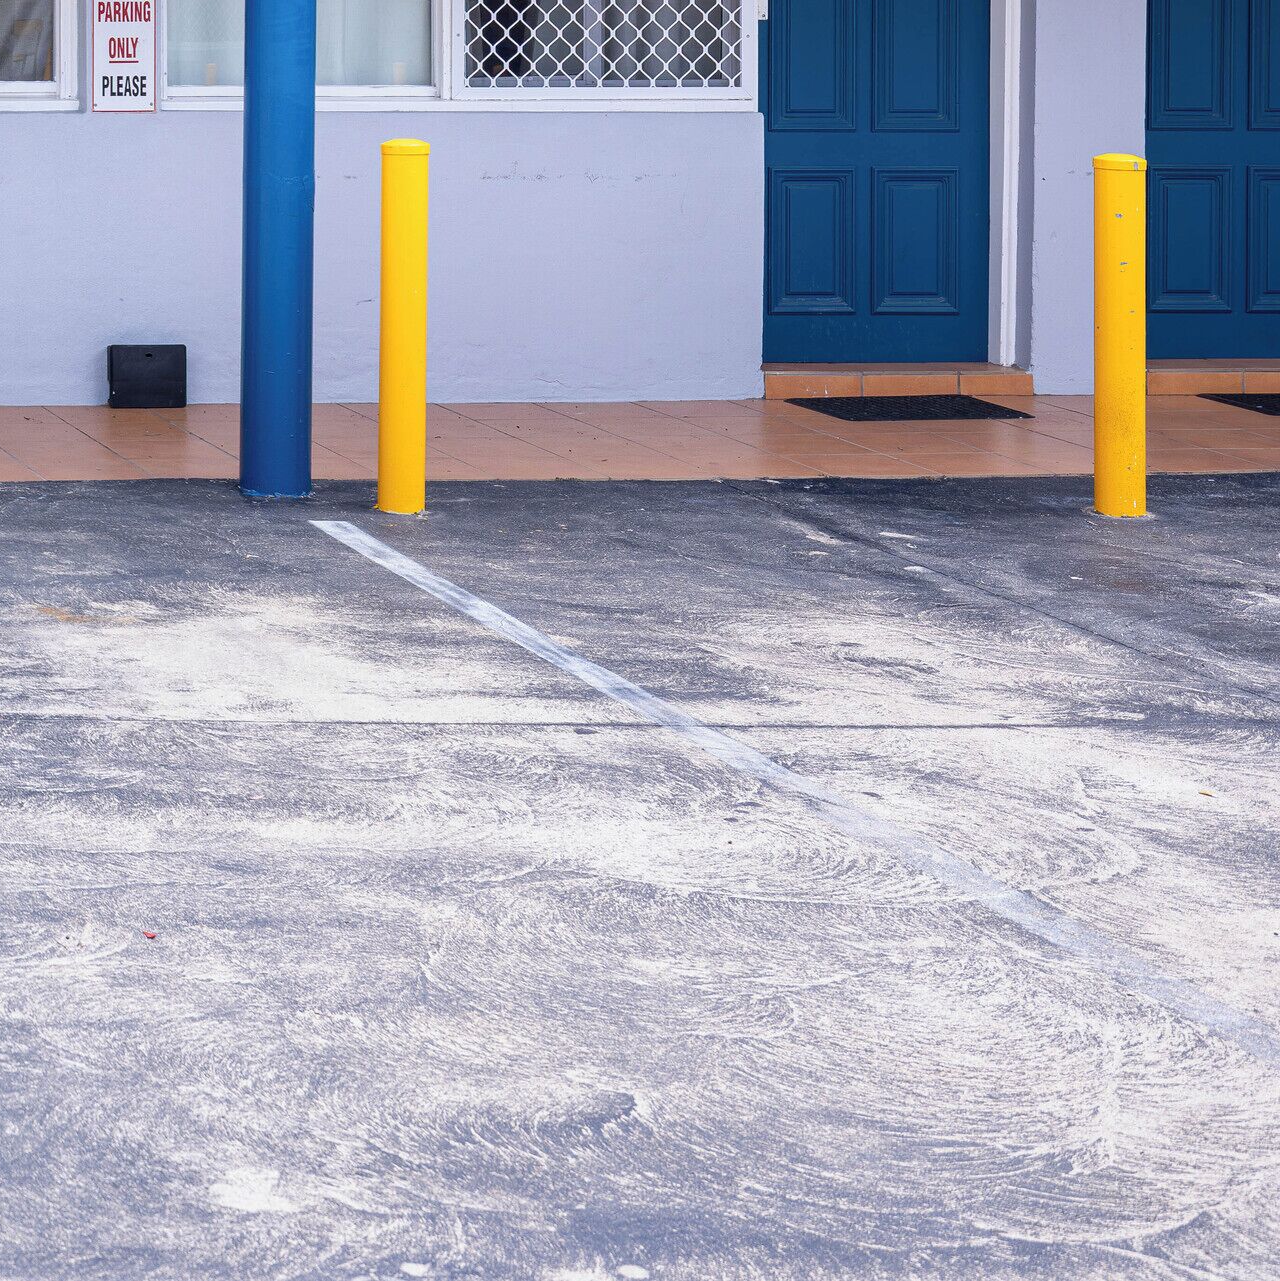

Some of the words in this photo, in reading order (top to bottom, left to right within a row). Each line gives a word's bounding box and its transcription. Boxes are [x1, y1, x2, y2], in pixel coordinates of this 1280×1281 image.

[97, 0, 151, 23] PARKING
[108, 36, 139, 59] ONLY
[101, 75, 147, 97] PLEASE
